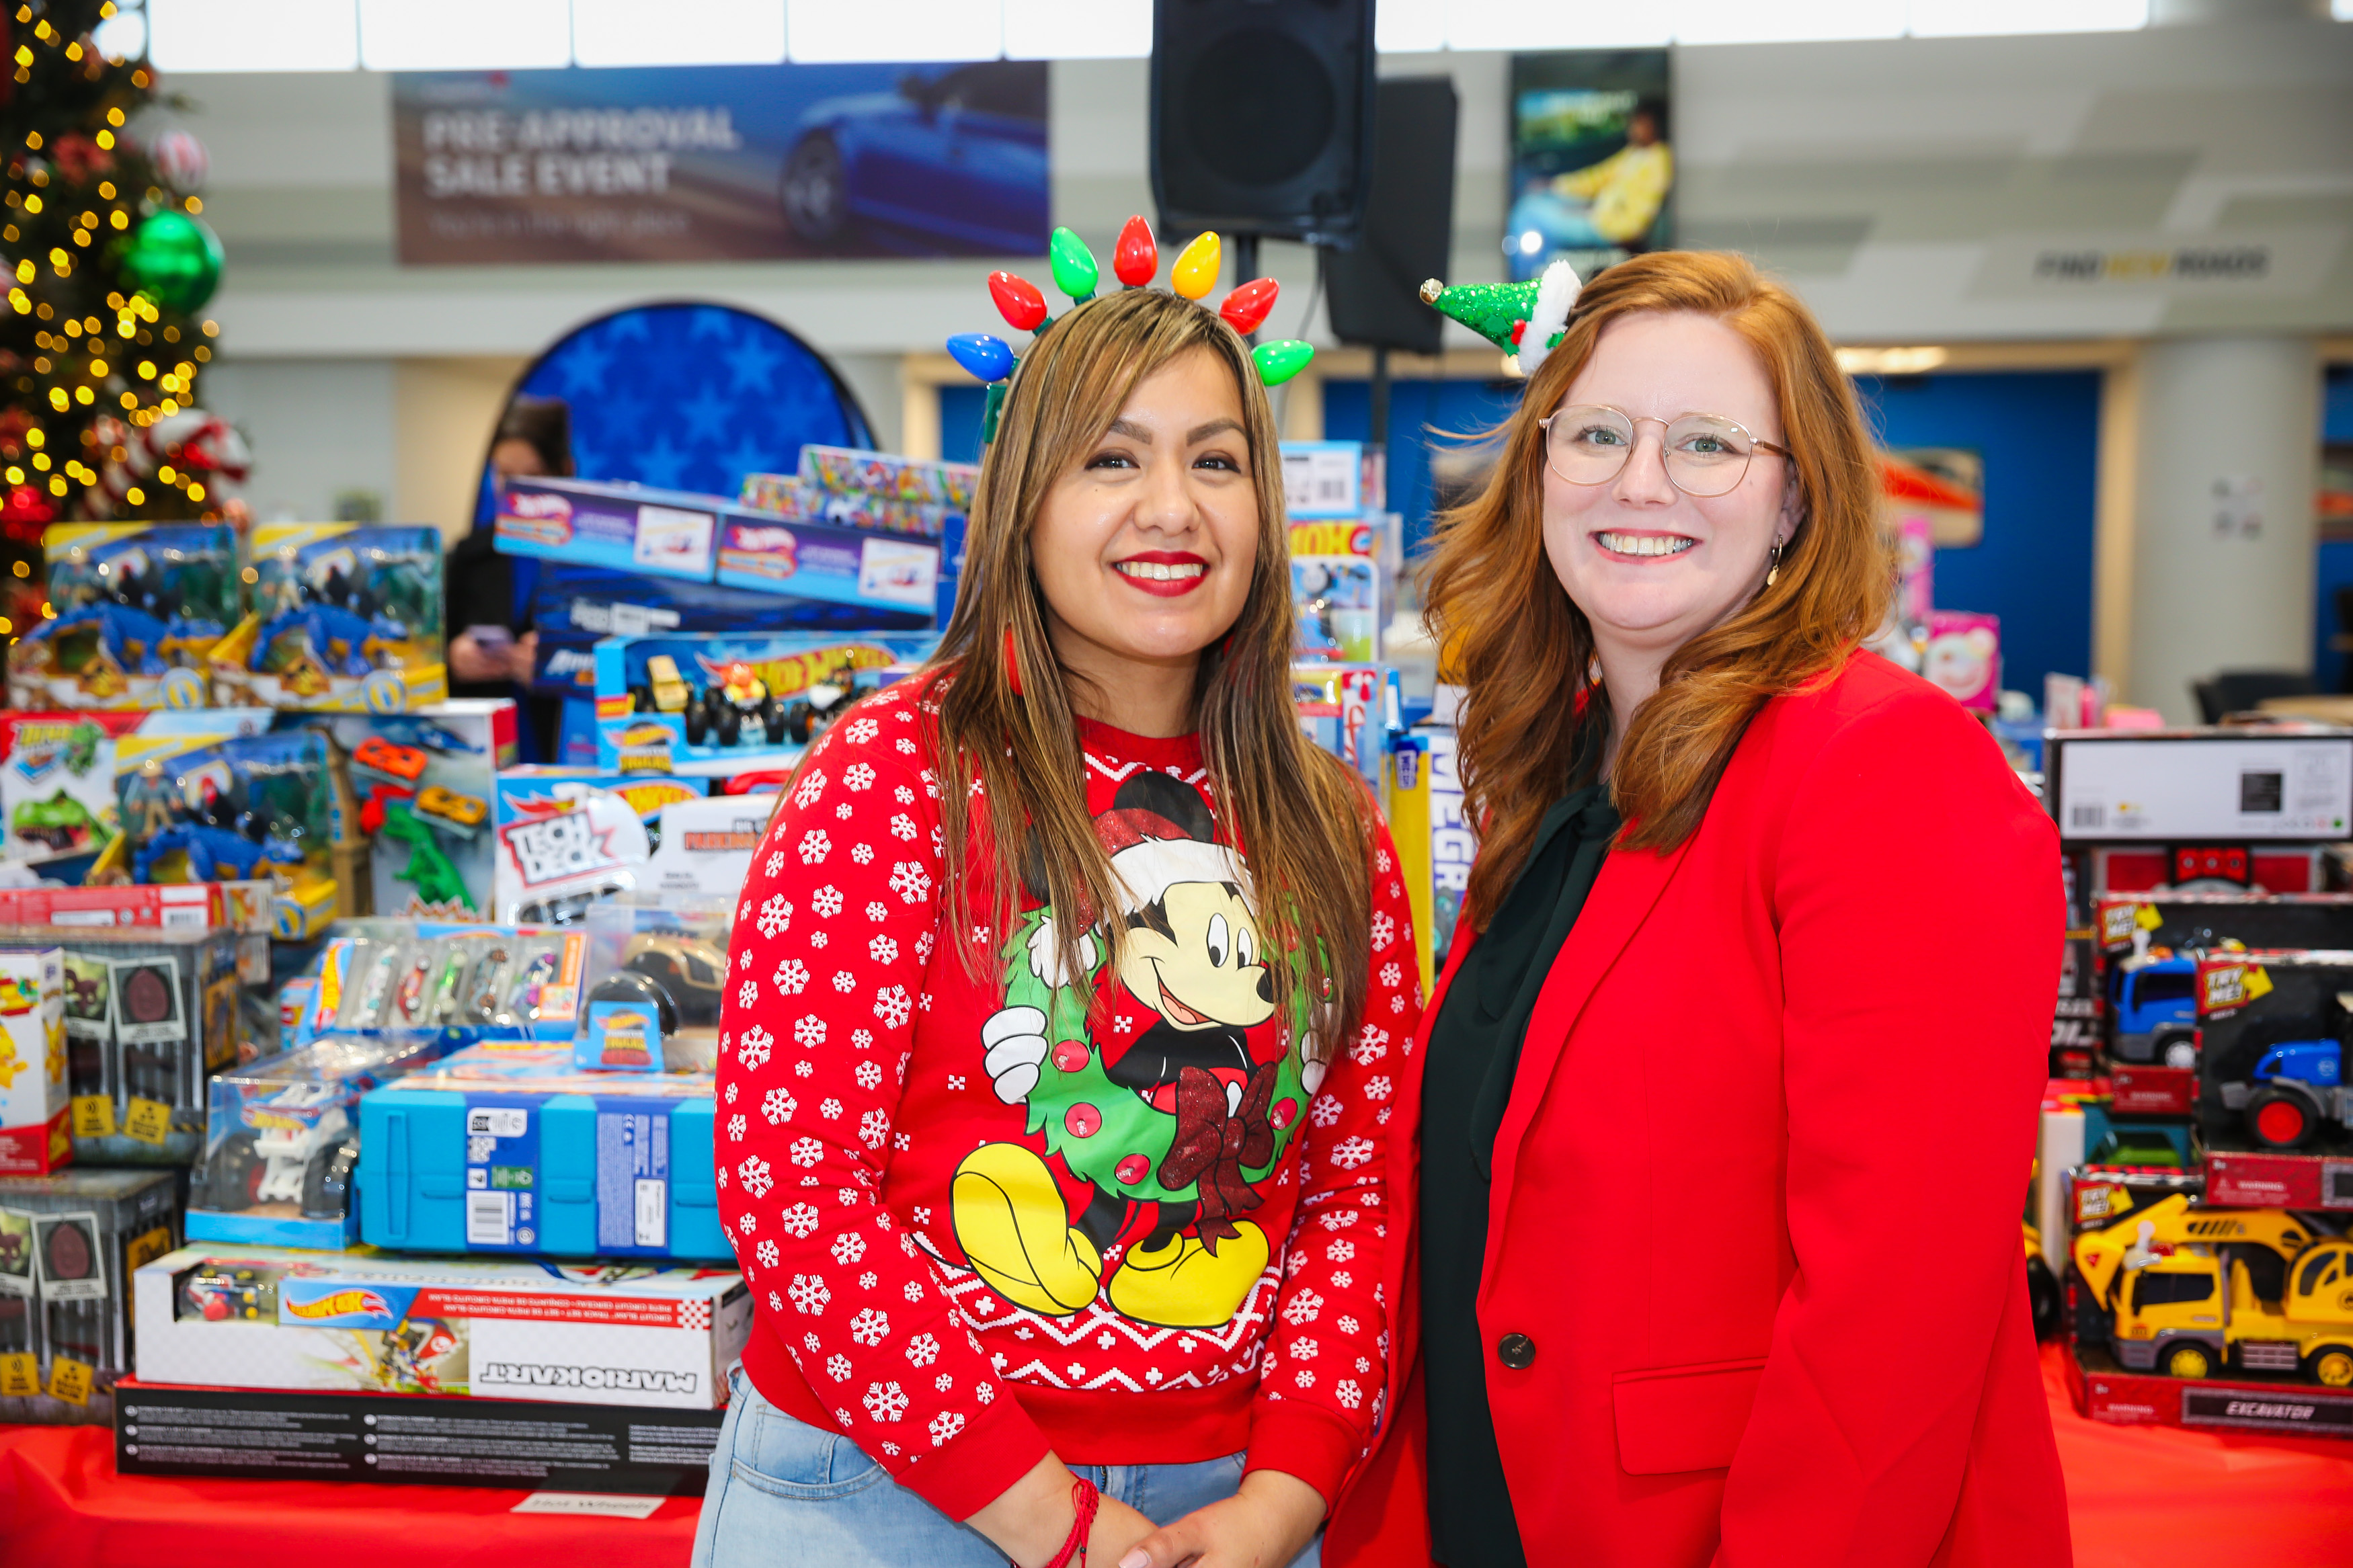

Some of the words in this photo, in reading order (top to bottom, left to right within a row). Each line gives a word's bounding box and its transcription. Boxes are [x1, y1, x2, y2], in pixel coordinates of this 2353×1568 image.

[424, 151, 530, 198] SALE
[534, 151, 671, 197] EVENT
[506, 812, 592, 854] TECH
[520, 837, 610, 883] DECK
[2208, 966, 2244, 989] TRY
[2237, 1181, 2285, 1191] WARNING
[583, 1309, 609, 1319] TRACK
[614, 1302, 647, 1311] CIRCUIT
[639, 1313, 672, 1323] CIRCUIT
[2226, 1401, 2315, 1420] EXCAVATOR
